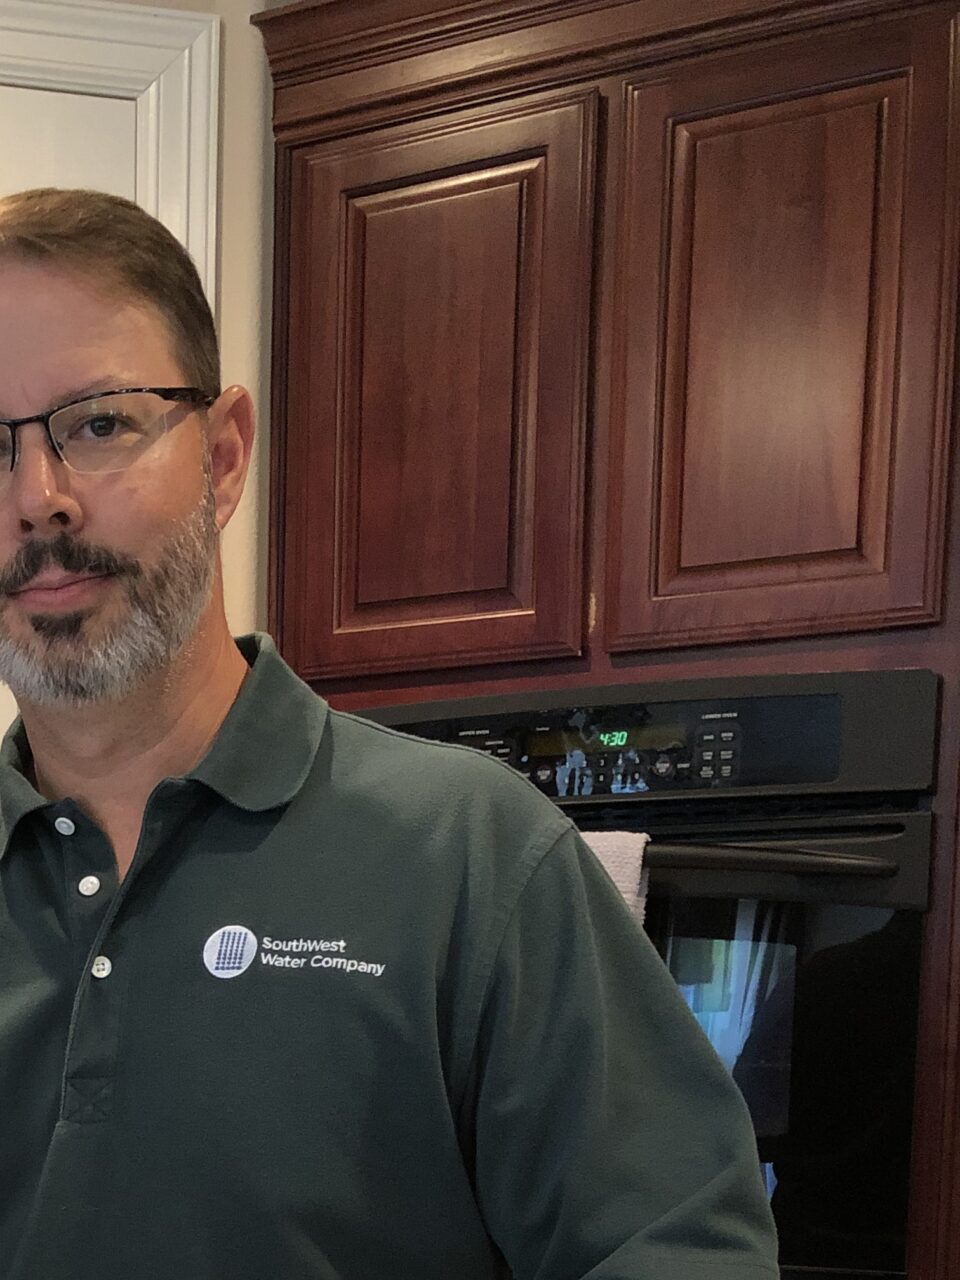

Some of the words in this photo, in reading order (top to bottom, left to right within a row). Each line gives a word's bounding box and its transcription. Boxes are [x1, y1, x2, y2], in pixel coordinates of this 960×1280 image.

[600, 731, 628, 747] 4:30
[262, 936, 347, 953] SouthWest
[260, 952, 306, 968] Water
[310, 955, 386, 977] Company
